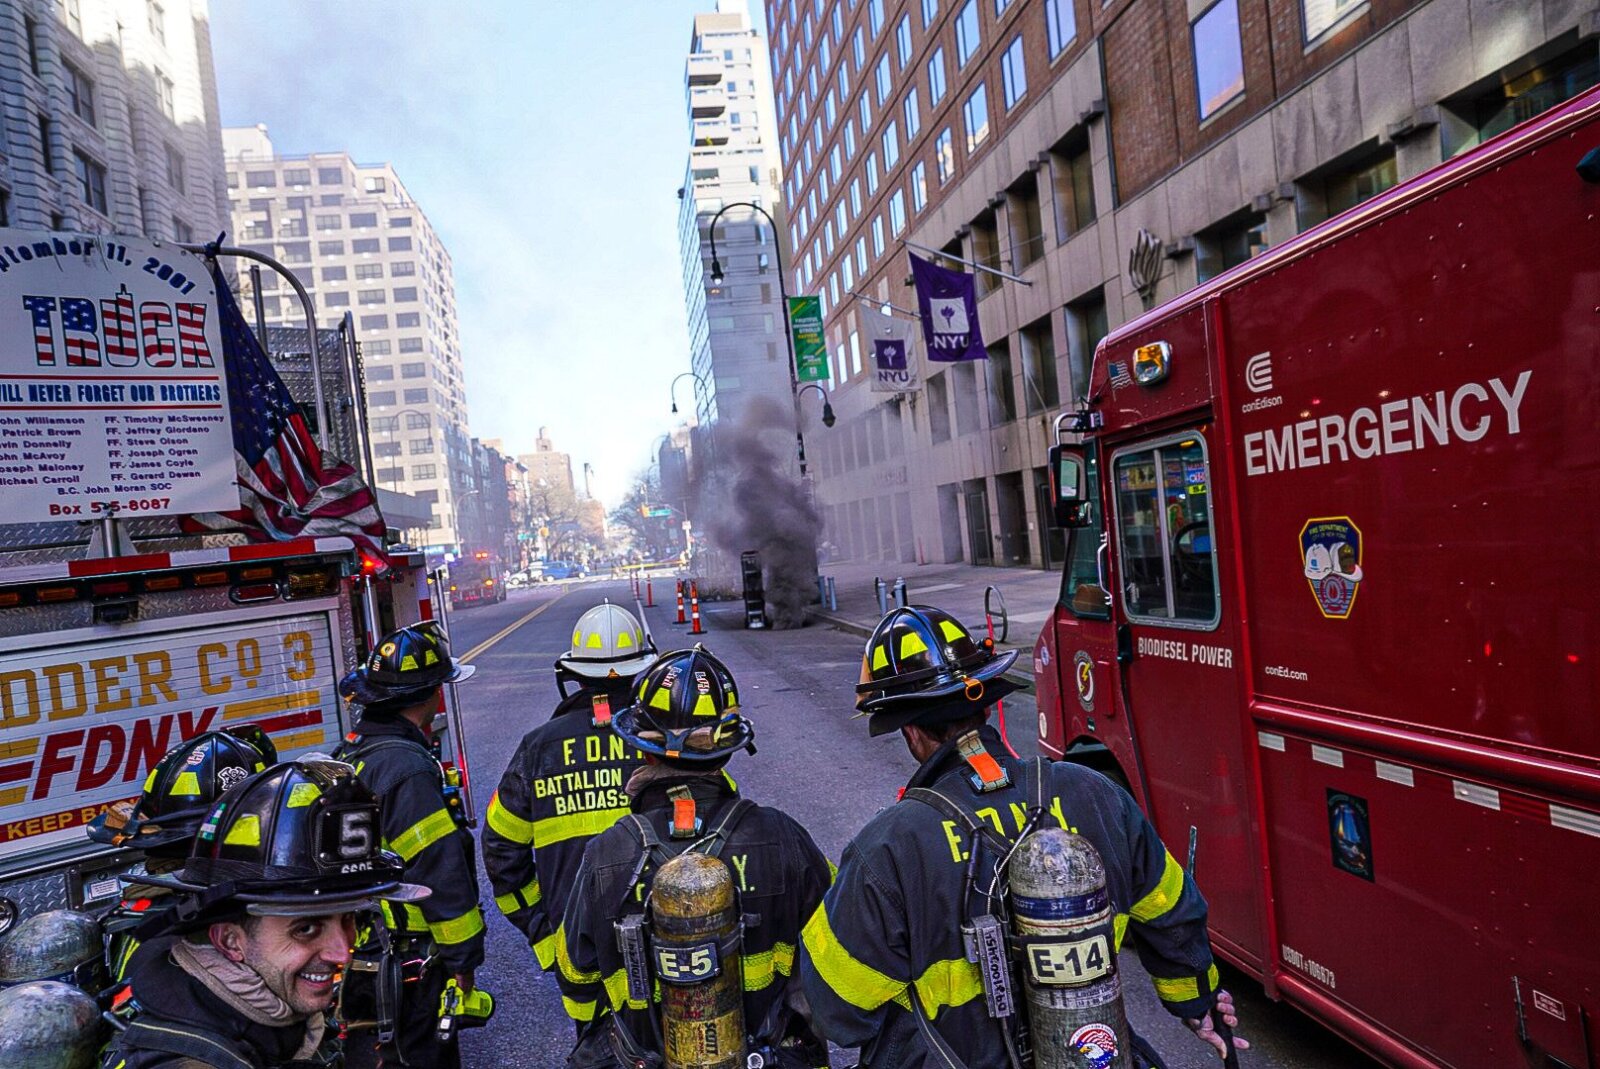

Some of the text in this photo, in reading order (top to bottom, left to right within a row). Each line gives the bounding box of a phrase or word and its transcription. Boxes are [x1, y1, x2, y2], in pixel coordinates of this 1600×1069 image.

[143, 257, 196, 295] 2001
[22, 290, 215, 368] TRUCK
[934, 335, 969, 349] NYU
[879, 371, 909, 382] NYU
[0, 384, 220, 402] ILL NEVER FORGET OUR BROTHERS
[25, 416, 85, 425] Williamson
[104, 414, 225, 424] FF. Timothy McSweeney
[1243, 370, 1533, 476] EMERGENCY
[2, 428, 81, 437] Patrick Brown
[105, 426, 210, 436] FF. Jeffrey Giordano
[0, 440, 72, 449] vin Donnelly
[107, 437, 189, 447] FF. Steve Olson
[23, 452, 66, 461] McAvoy
[108, 448, 198, 458] FF. Joseph Ogren
[38, 463, 84, 472] Maloney
[129, 460, 162, 469] James
[166, 459, 194, 468] Coyle
[42, 475, 80, 484] Carroll
[110, 471, 201, 481] FF. Gerard Dewan
[57, 482, 172, 496] B.C. John Moran SOC
[49, 498, 170, 516] Box 55-8087
[1138, 636, 1233, 668] BIODIESEL POWER
[0, 650, 178, 730] DDER
[283, 631, 316, 682] 3
[1265, 665, 1308, 681] conEd.com
[32, 707, 219, 800] FDNY
[535, 768, 623, 799] BATTALION
[555, 789, 631, 816] BALDASS
[7, 812, 73, 840] KEEP
[341, 811, 372, 856] 5
[659, 949, 712, 978] E-5
[1033, 942, 1105, 979] E-14
